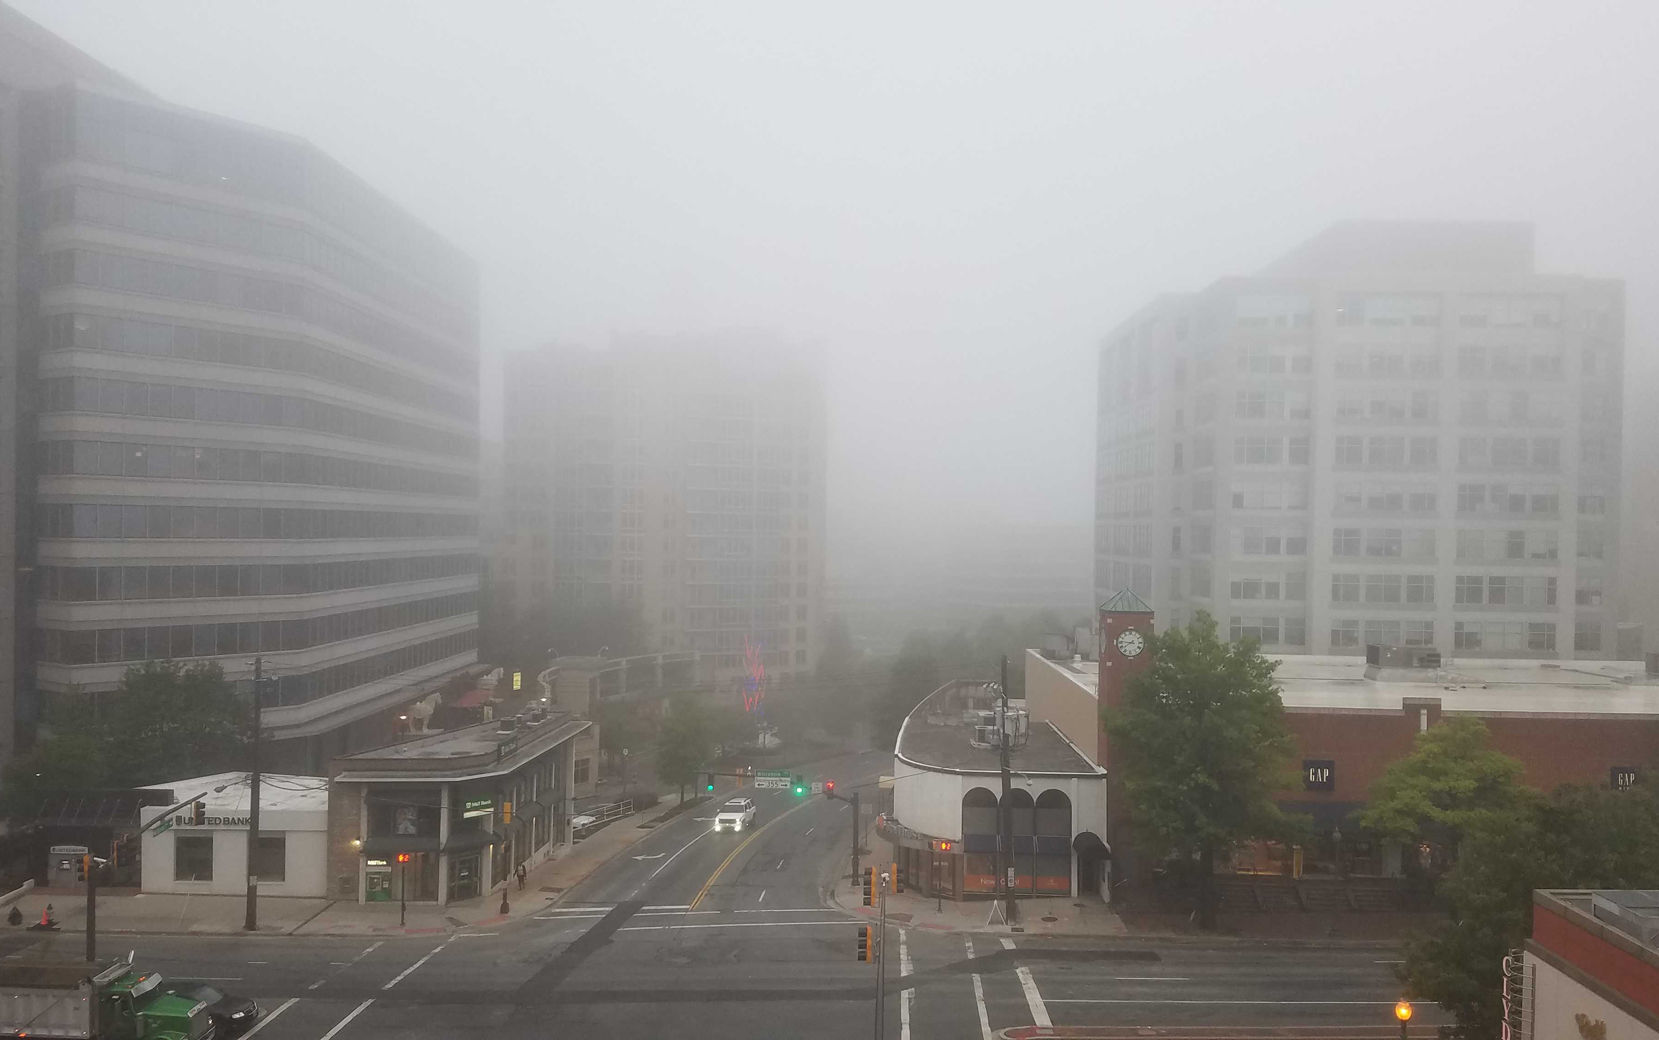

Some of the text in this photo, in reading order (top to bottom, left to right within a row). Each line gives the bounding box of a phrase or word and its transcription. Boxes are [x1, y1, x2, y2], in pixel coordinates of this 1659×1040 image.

[1309, 768, 1329, 782] GAP
[1618, 773, 1635, 785] GAP
[223, 817, 251, 825] BANK
